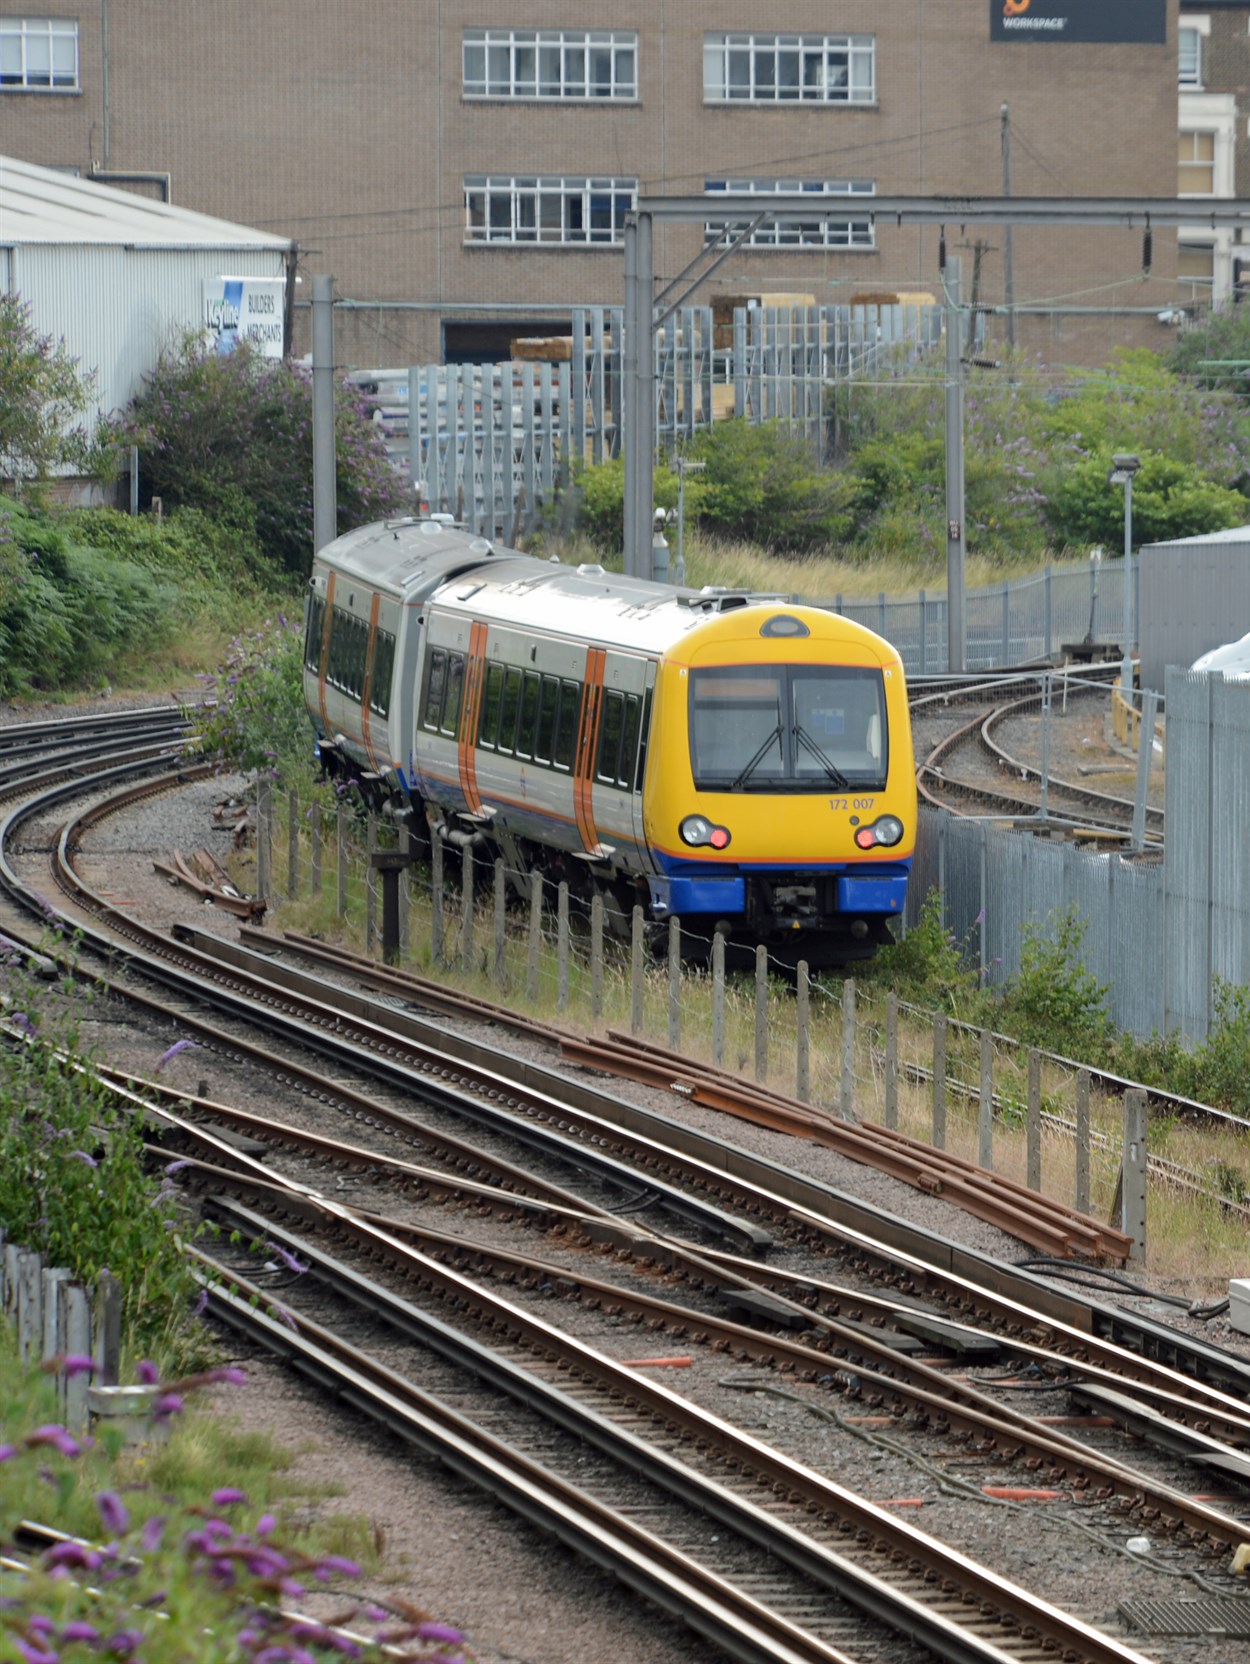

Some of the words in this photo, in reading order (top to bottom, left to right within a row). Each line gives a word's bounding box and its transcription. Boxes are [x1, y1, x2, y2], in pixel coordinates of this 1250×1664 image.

[1003, 17, 1064, 30] WORKSPACE
[248, 294, 275, 314] BUILDERS
[206, 299, 239, 335] Keyline
[247, 323, 281, 343] MERCHANTS
[829, 799, 848, 810] 172
[853, 798, 874, 809] 007
